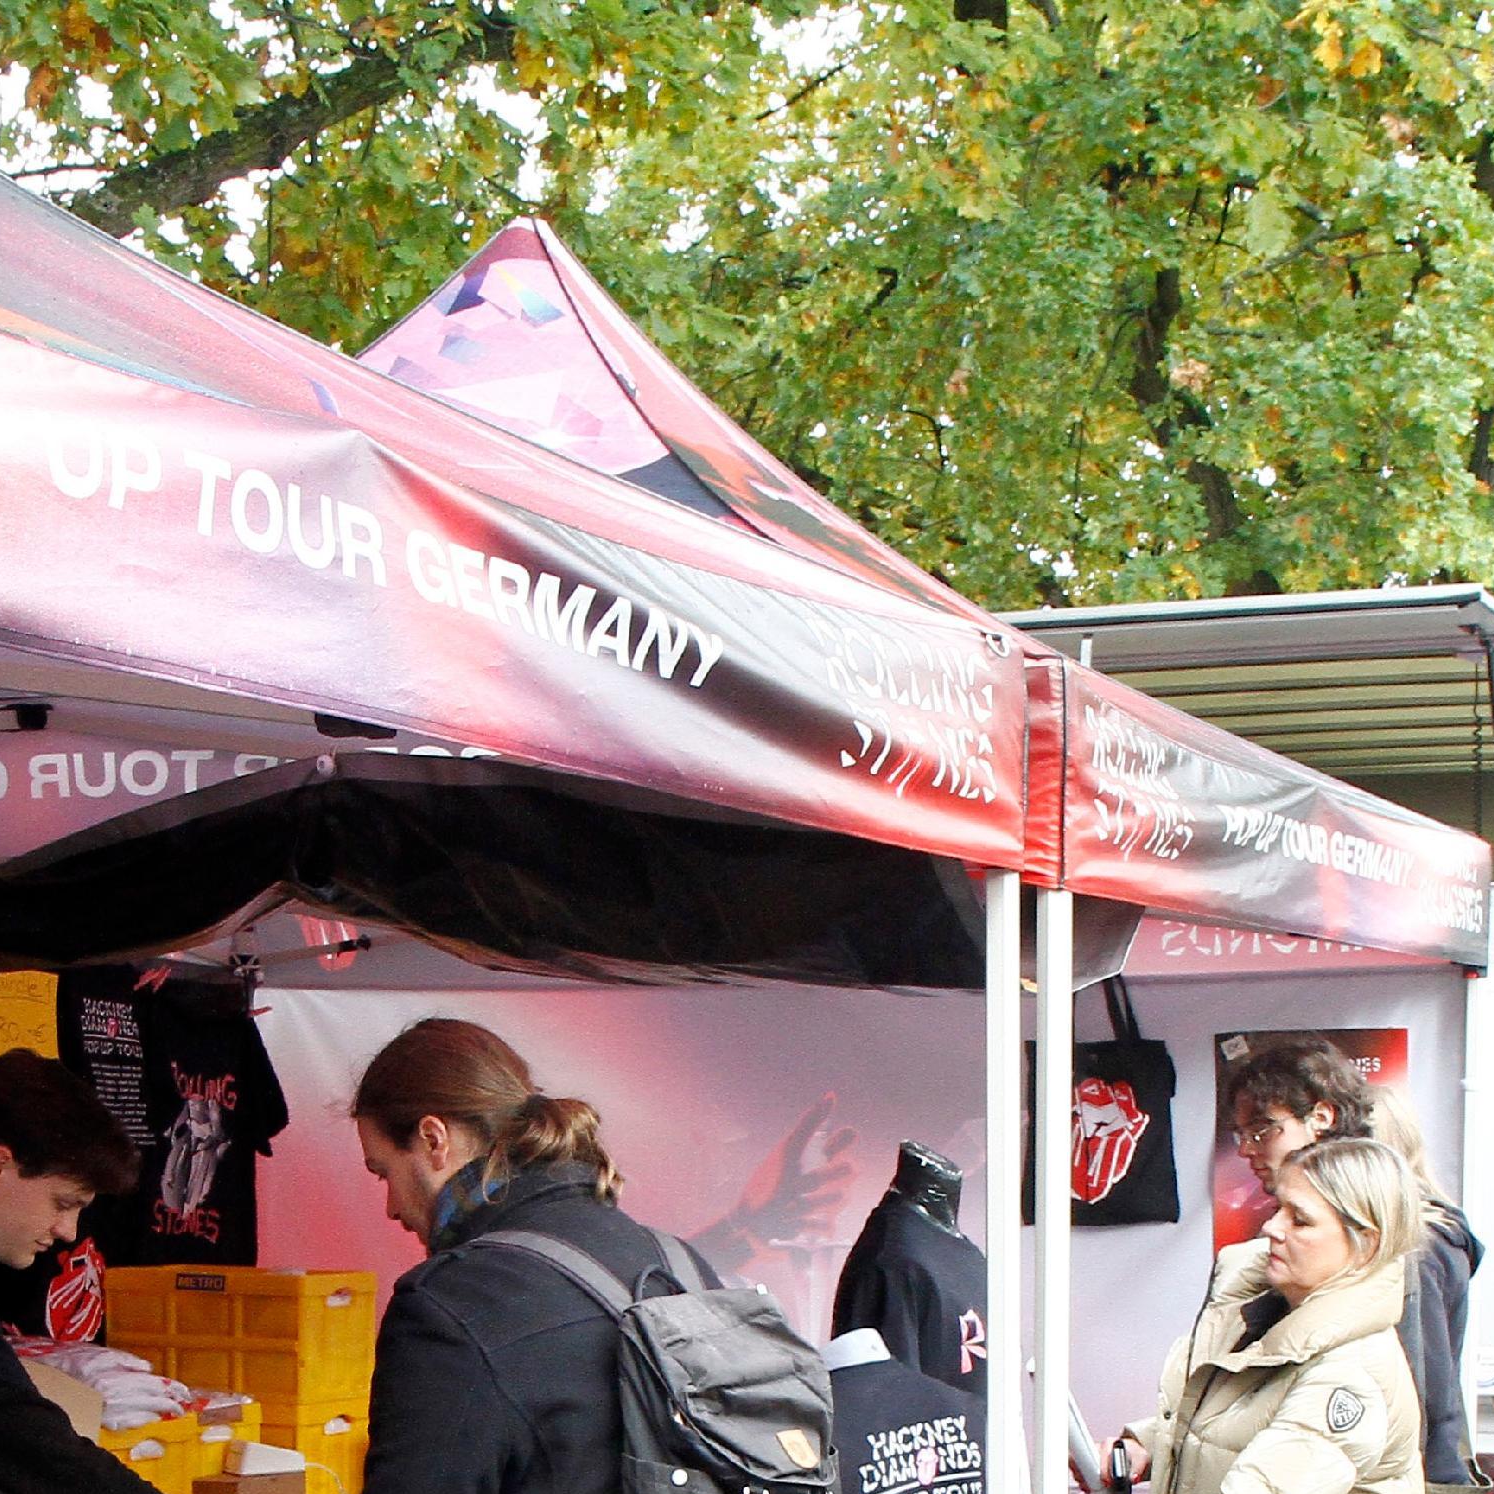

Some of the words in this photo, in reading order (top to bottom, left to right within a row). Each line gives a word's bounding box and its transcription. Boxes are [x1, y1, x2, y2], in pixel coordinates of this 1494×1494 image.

[44, 418, 162, 512] UP
[184, 450, 387, 587] TOUR
[405, 531, 725, 689] GERMANY
[1216, 804, 1261, 848] POP
[1255, 810, 1286, 853] UP
[1280, 817, 1330, 865] TOUR
[1330, 831, 1413, 888] GERMANY
[151, 1199, 221, 1245] STONES
[867, 1415, 967, 1461] HACKNEY
